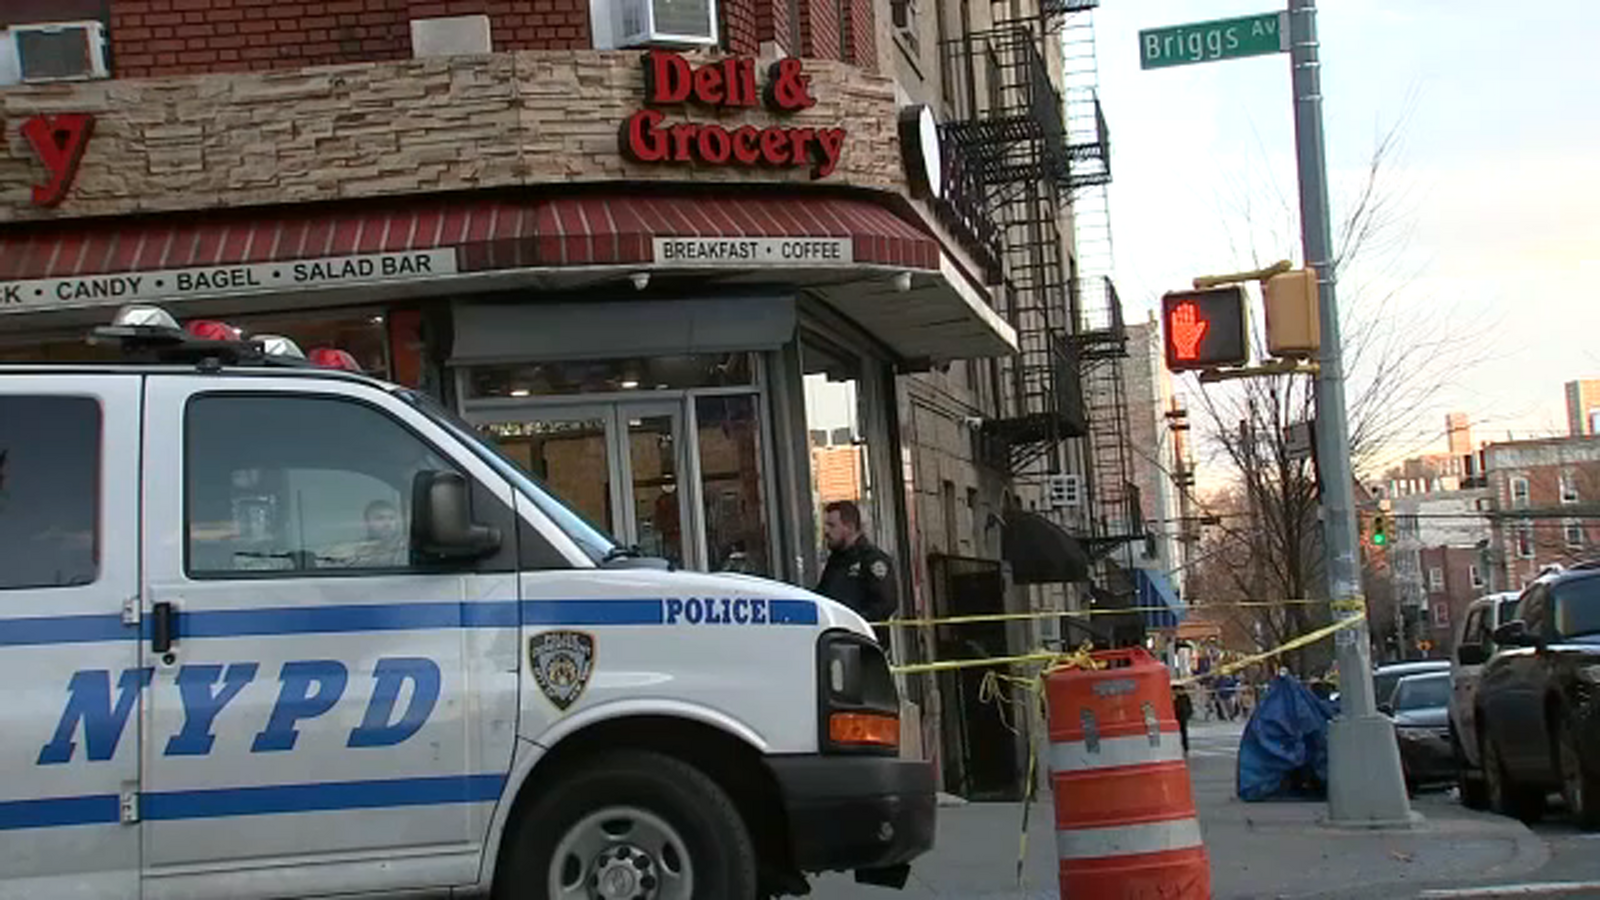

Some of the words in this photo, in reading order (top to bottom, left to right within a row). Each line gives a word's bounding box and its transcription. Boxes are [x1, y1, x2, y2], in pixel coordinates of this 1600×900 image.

[1145, 28, 1239, 60] Briggs
[645, 51, 757, 106] Deli
[767, 56, 816, 110] &
[620, 108, 847, 180] Grocery
[663, 241, 758, 259] BREAKFAST
[781, 241, 841, 259] COFFEE
[56, 276, 142, 300] CANDY
[177, 268, 260, 292] BAGEL
[293, 258, 374, 282] SALAD
[382, 254, 431, 276] BAR
[664, 599, 767, 624] POLICE
[36, 657, 442, 765] NYPD
